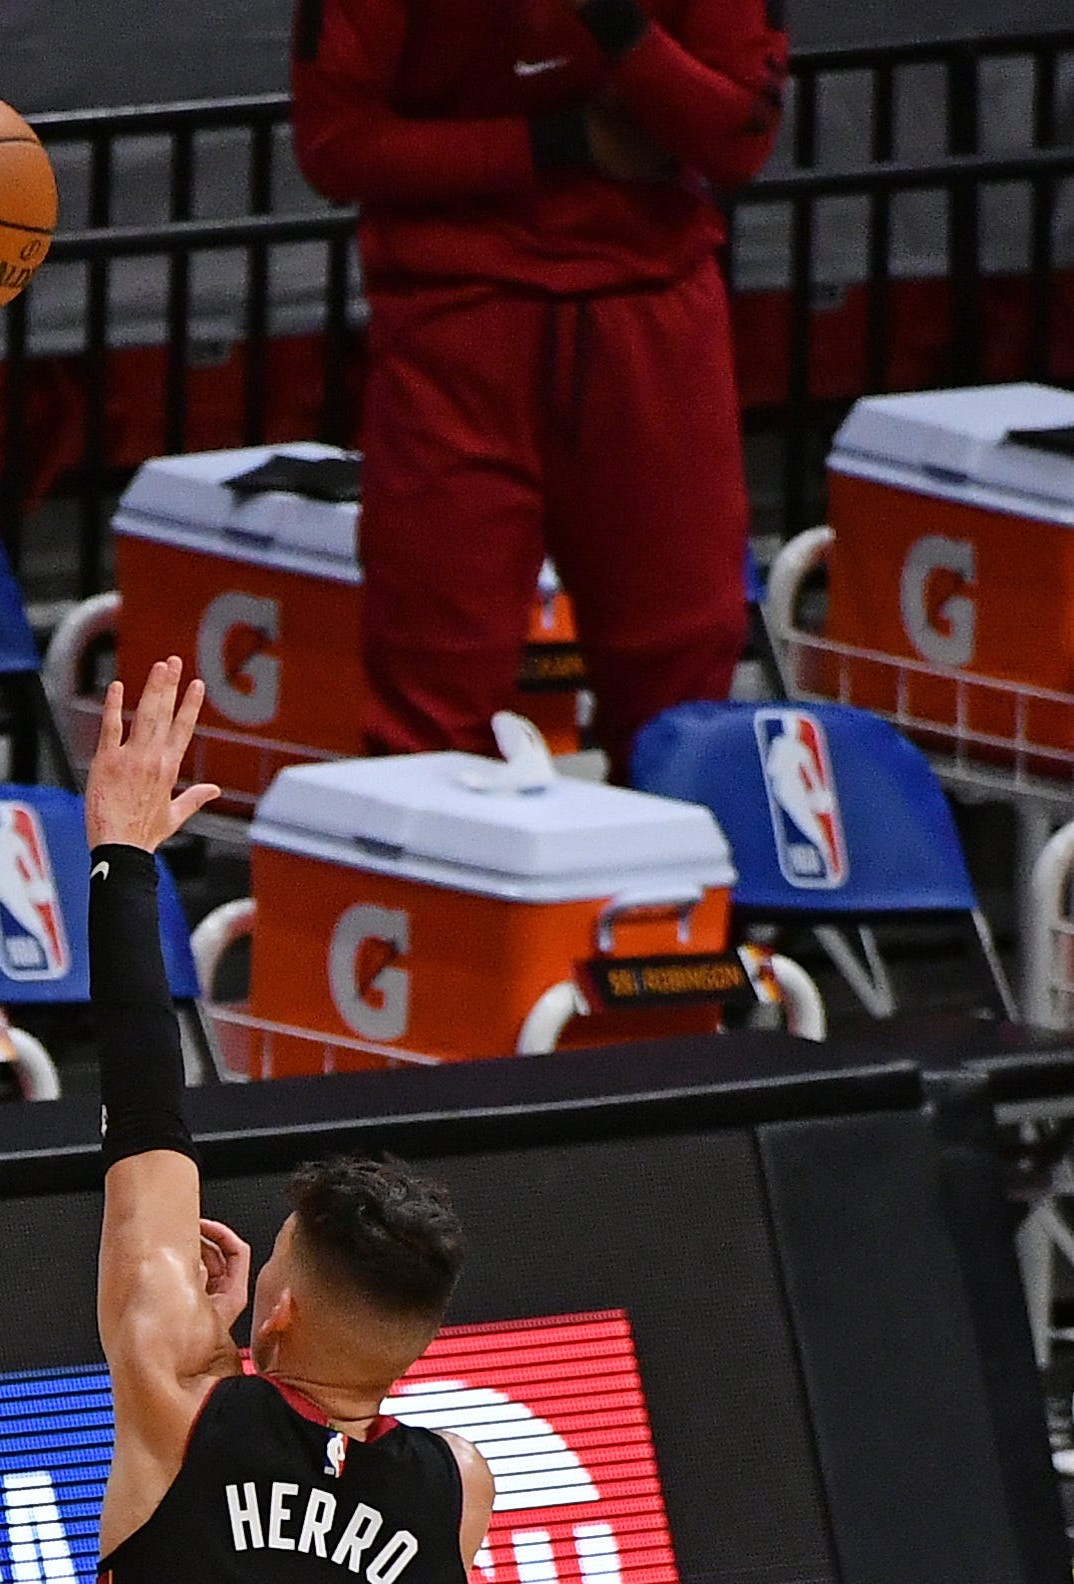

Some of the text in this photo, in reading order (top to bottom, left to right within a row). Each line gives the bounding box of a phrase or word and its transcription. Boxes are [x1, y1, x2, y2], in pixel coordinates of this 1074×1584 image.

[197, 592, 281, 725] G
[900, 534, 976, 669] G
[329, 903, 410, 1041] G
